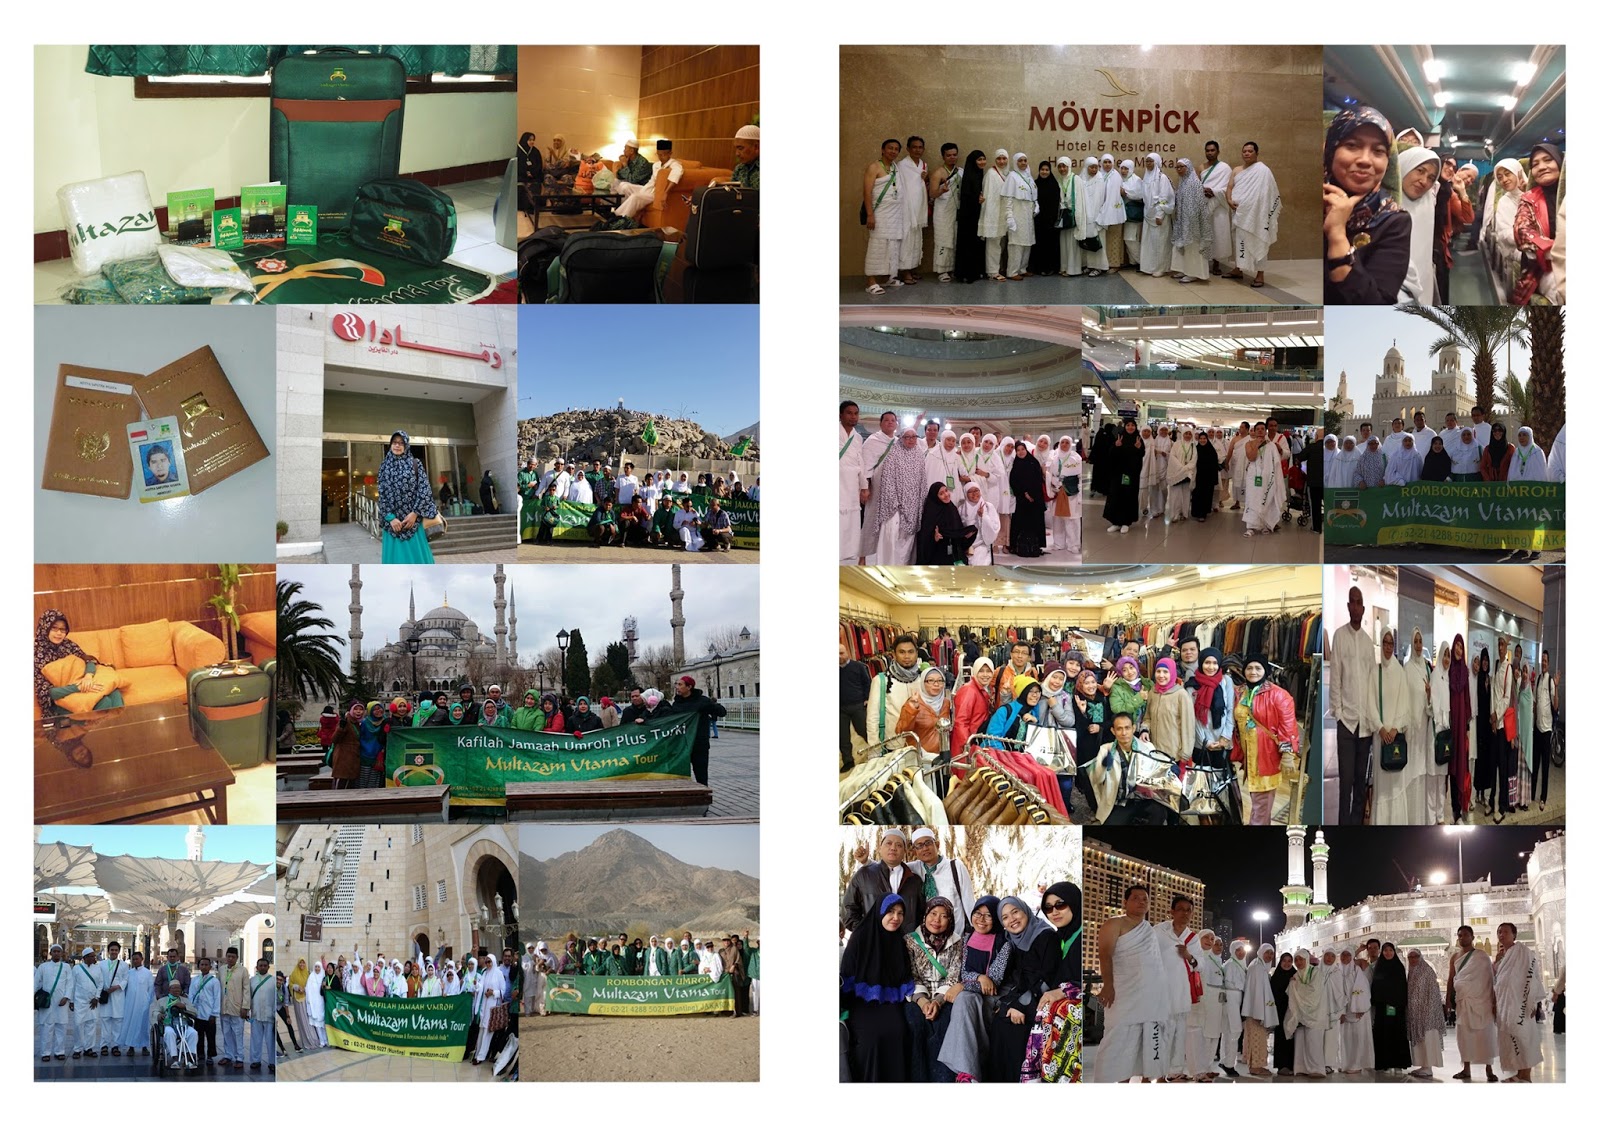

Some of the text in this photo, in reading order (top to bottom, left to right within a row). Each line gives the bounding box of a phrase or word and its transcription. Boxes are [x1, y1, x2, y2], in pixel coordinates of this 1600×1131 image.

[1056, 140, 1176, 152] Hotel & Residence
[1401, 485, 1557, 498] ROMBONGAN UMROH
[1382, 497, 1469, 523] Multazam
[1455, 532, 1479, 544] 5027
[1483, 533, 1532, 548] (Hunting)
[457, 723, 687, 751] Kafilah Jamaah Umroh Plus Turki
[485, 754, 659, 776] Multazam Utama Tour
[606, 978, 673, 986] ROMBONGAN
[592, 986, 726, 1002] Multazam Utama Tour
[369, 1001, 454, 1011] KAFILAH JAMAAH UMROH
[648, 1005, 665, 1013] 5027
[356, 1008, 466, 1032] Multazam Utama Tour
